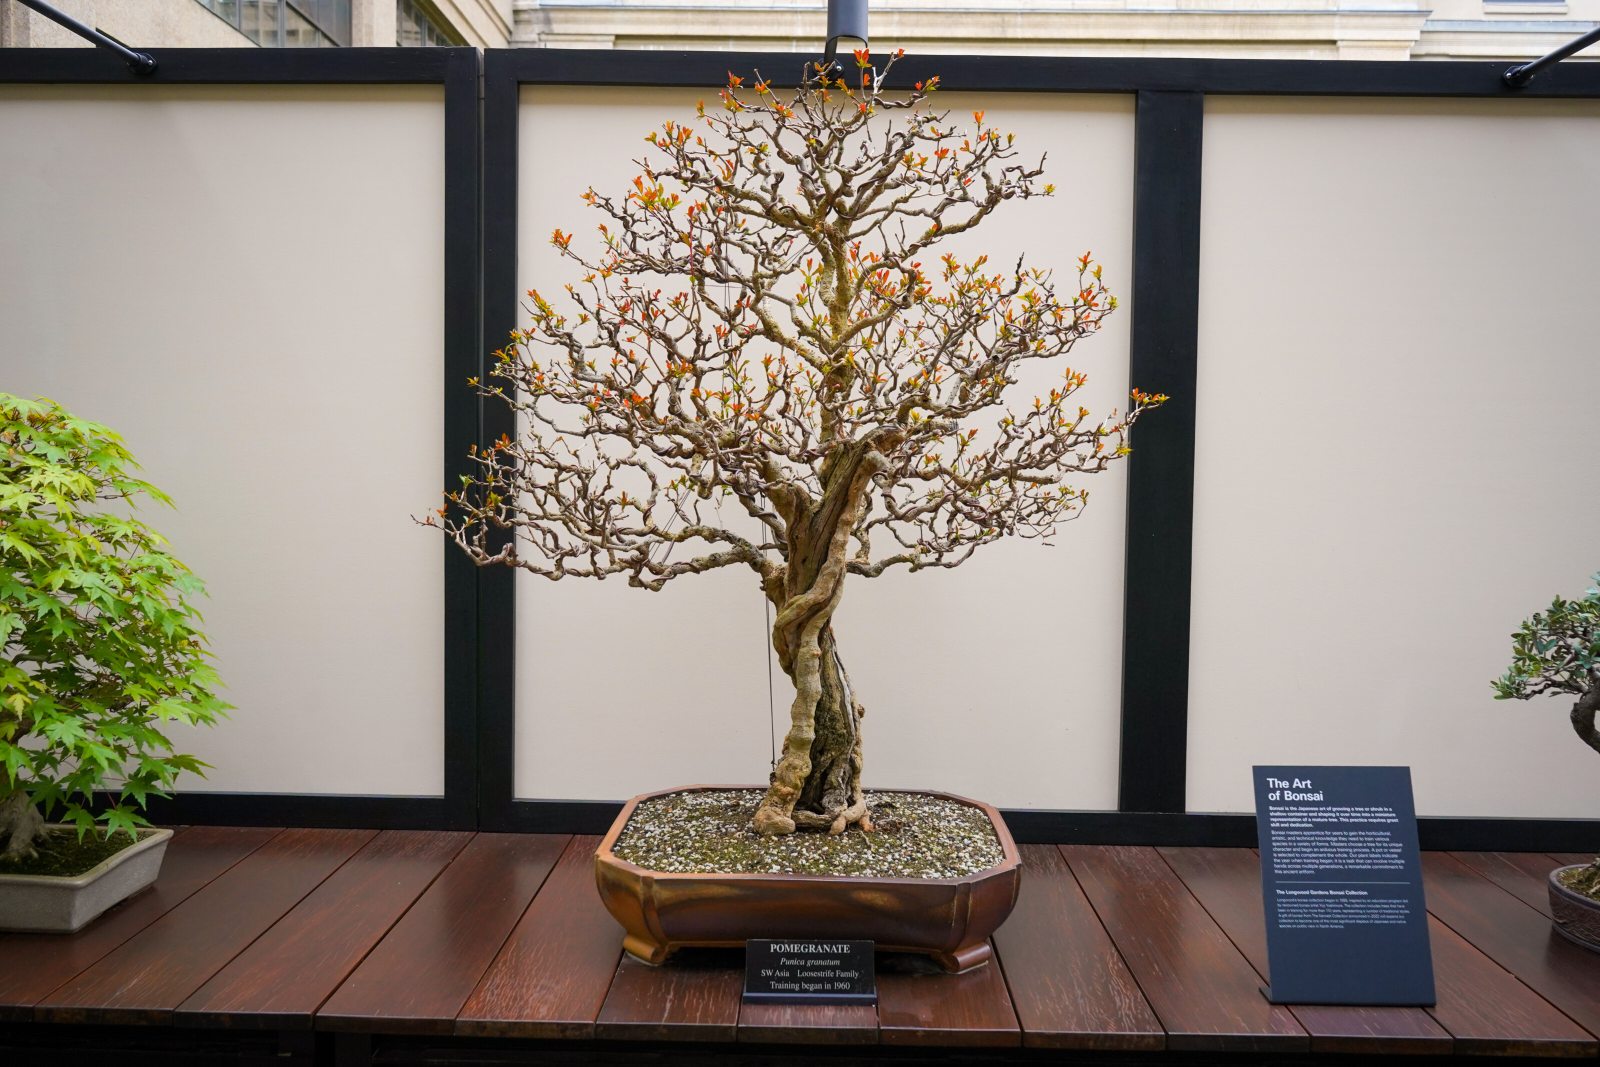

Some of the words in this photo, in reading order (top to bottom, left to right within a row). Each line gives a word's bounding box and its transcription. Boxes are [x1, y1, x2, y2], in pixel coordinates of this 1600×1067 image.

[1267, 778, 1289, 788] The
[1293, 778, 1312, 788] Art
[1268, 791, 1280, 800] of
[1284, 791, 1323, 801] Bonsai
[770, 944, 850, 953] POMEGRANATE
[836, 970, 859, 979] Family
[770, 981, 800, 991] Training
[802, 982, 822, 991] began
